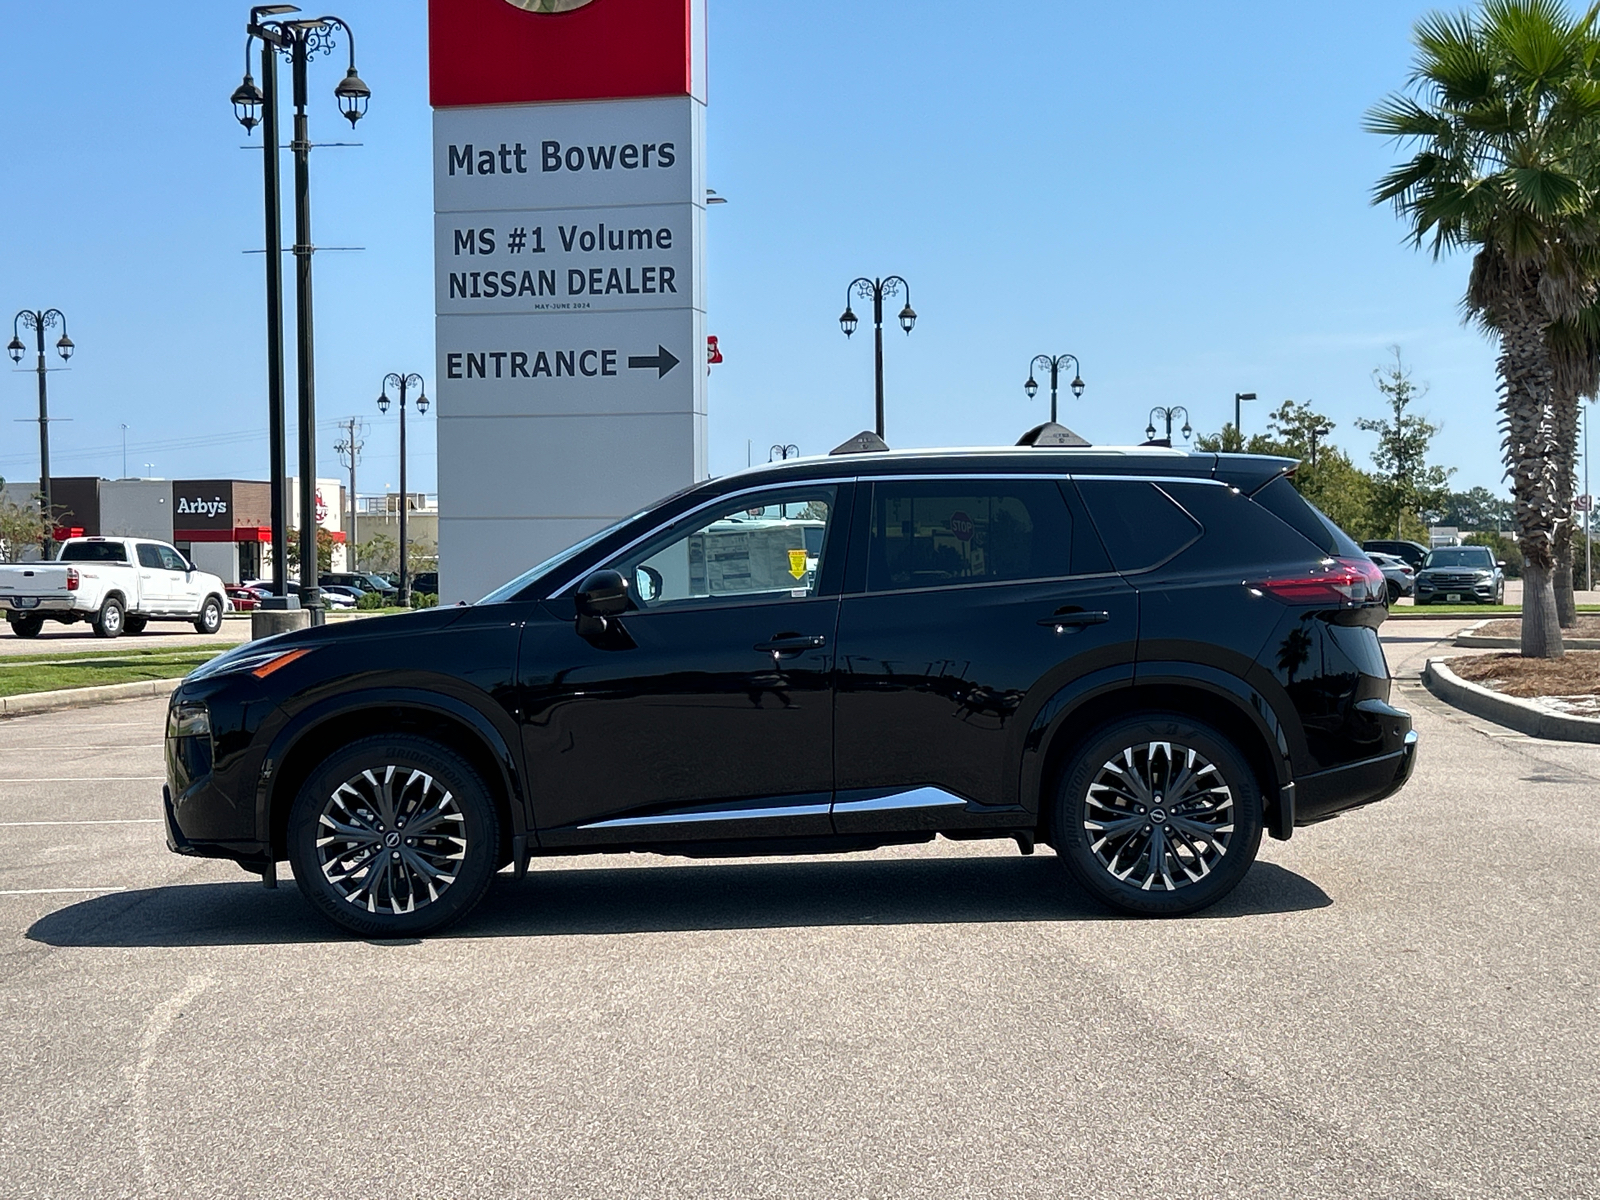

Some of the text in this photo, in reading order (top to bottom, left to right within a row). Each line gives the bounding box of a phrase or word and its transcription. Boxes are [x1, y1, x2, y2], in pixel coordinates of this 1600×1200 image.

[448, 140, 676, 176] Matt Bowers
[454, 223, 673, 256] MS #1 Volume
[449, 266, 678, 299] NISSAN DEALER
[446, 349, 618, 379] ENTRANCE
[177, 496, 227, 518] Arby's
[952, 520, 972, 533] STOP
[385, 747, 467, 792] BRIDGESTONE
